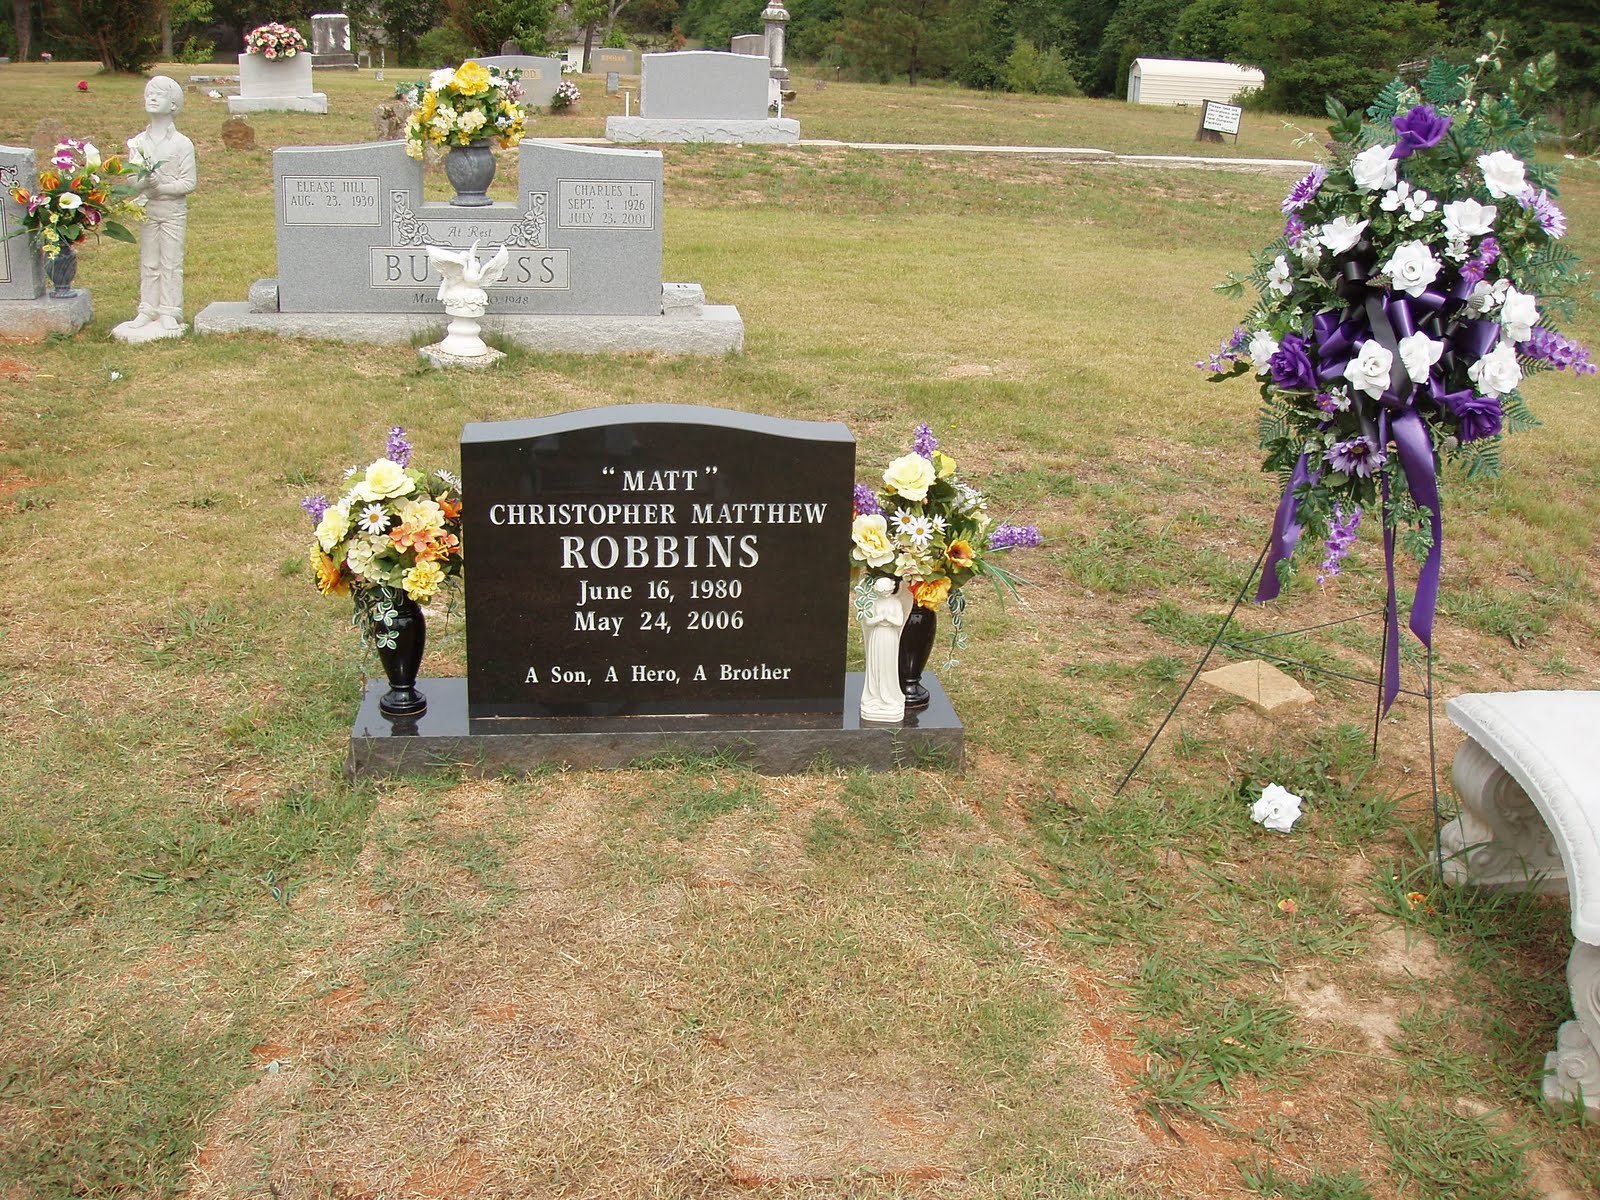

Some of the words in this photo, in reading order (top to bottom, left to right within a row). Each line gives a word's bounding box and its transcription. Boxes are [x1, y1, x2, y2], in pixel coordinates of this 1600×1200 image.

[297, 181, 336, 192] ELEASE
[343, 182, 367, 193] HILL
[574, 184, 623, 197] CHARLES
[629, 186, 639, 197] L.
[290, 195, 315, 206] AUG.
[325, 195, 342, 207] 23.
[351, 195, 375, 207] 1930
[567, 198, 595, 210] SEPT.
[606, 200, 613, 210] 1.
[624, 200, 645, 211] 1926
[568, 212, 594, 224] JULY
[602, 212, 617, 224] 23.
[622, 213, 646, 225] 2001
[447, 226, 461, 238] At
[467, 226, 492, 239] Rest
[384, 254, 555, 284] BUSS
[505, 295, 529, 305] 1948
[489, 503, 677, 526] CHRISTOPHER
[690, 503, 828, 524] MATTHEW
[559, 534, 759, 570] ROBBINS
[576, 580, 633, 607] June
[647, 579, 675, 604] 16,
[690, 579, 743, 599] 1980
[573, 610, 624, 637] May
[639, 611, 672, 635] 24,
[686, 610, 744, 630] 2006
[524, 666, 539, 684] A
[551, 665, 592, 686] Son,
[604, 665, 619, 683] A
[631, 665, 681, 685] Hero,
[692, 664, 708, 681] A
[719, 663, 792, 681] Brother
